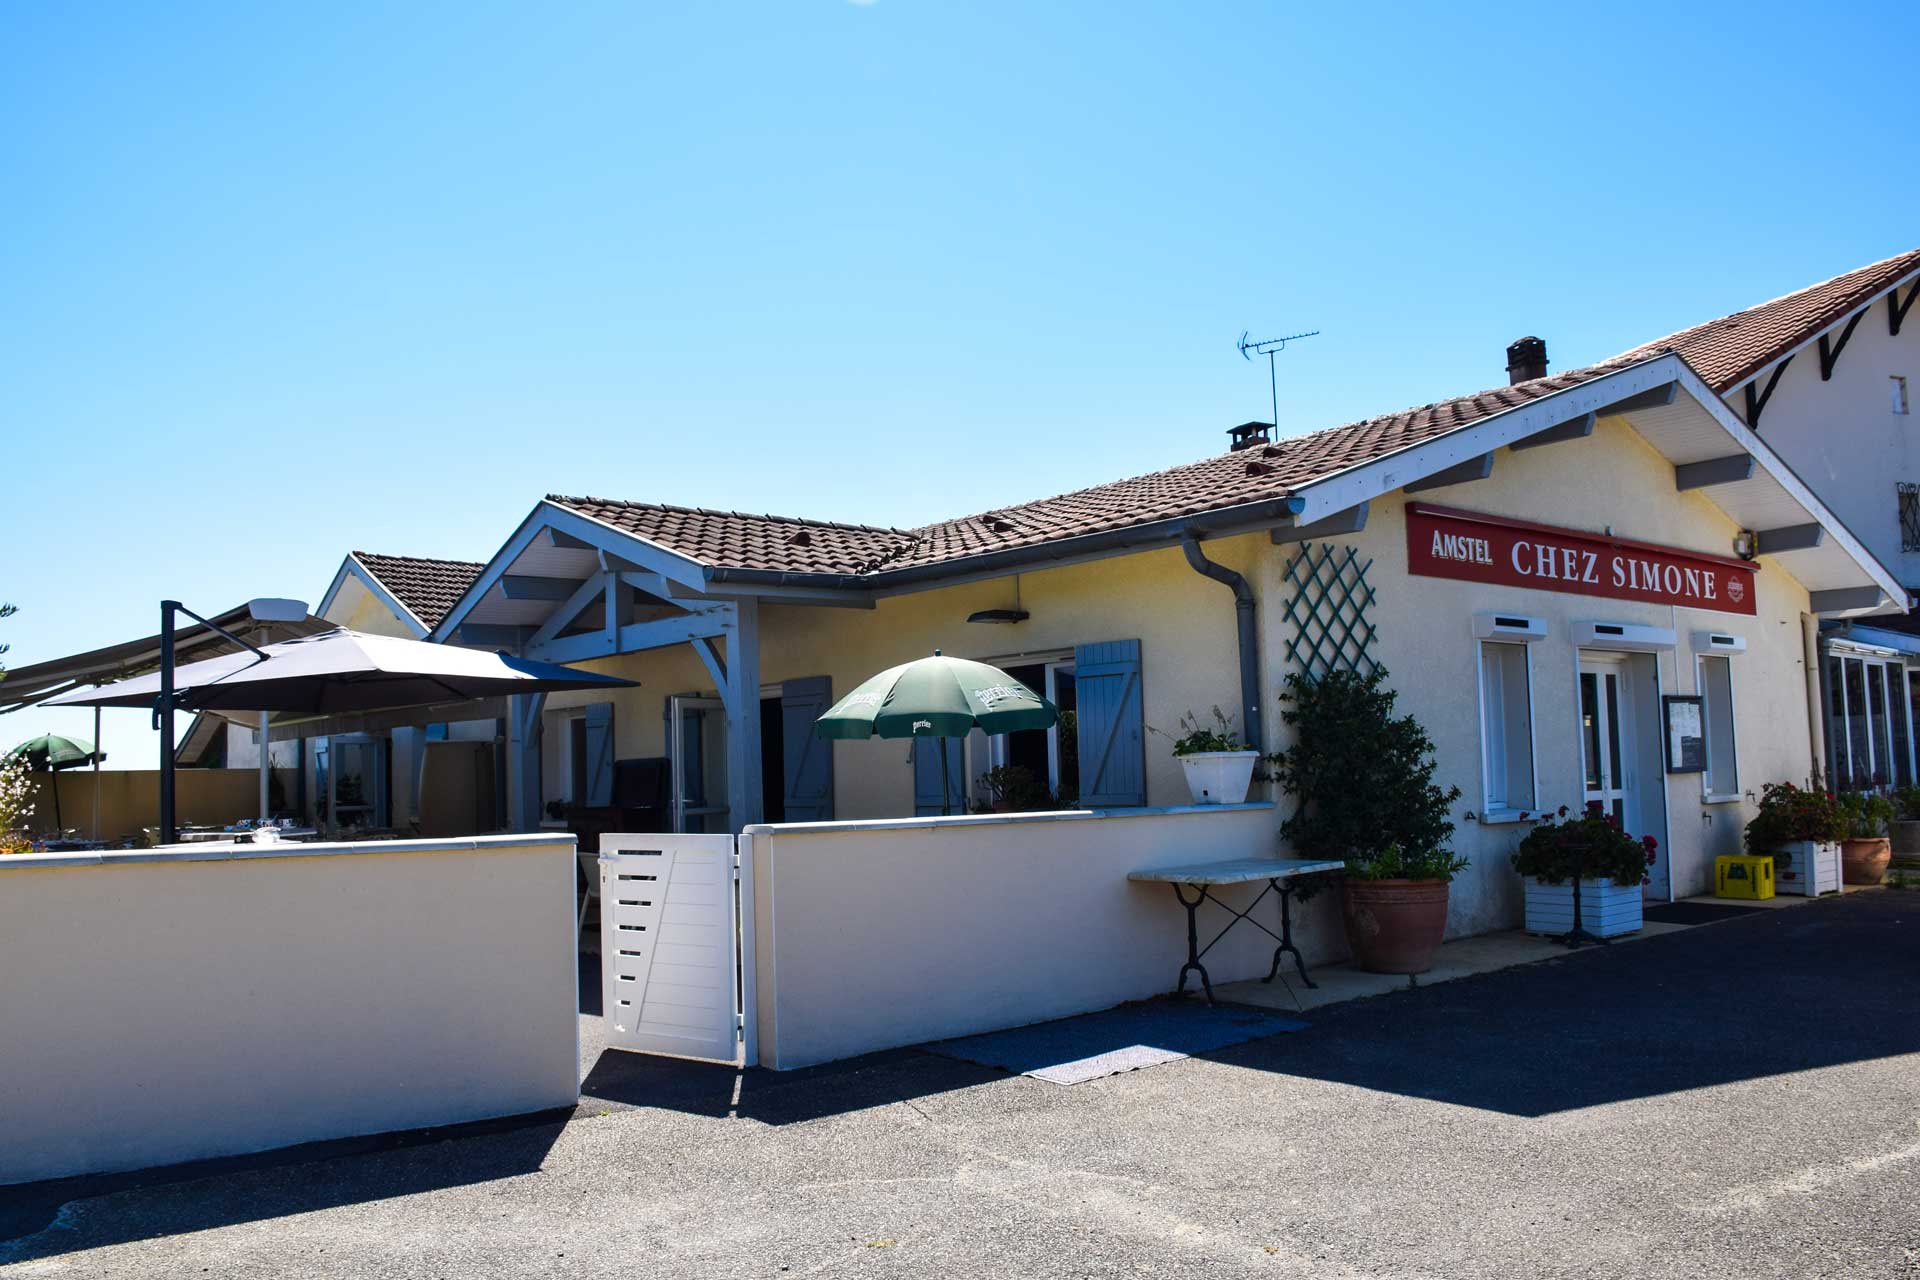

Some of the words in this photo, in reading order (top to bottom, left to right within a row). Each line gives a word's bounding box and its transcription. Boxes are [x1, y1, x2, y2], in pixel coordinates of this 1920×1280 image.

[1431, 529, 1493, 565] AMSTEL
[1511, 541, 1599, 584] CHEZ
[1612, 556, 1717, 600] SIMONE
